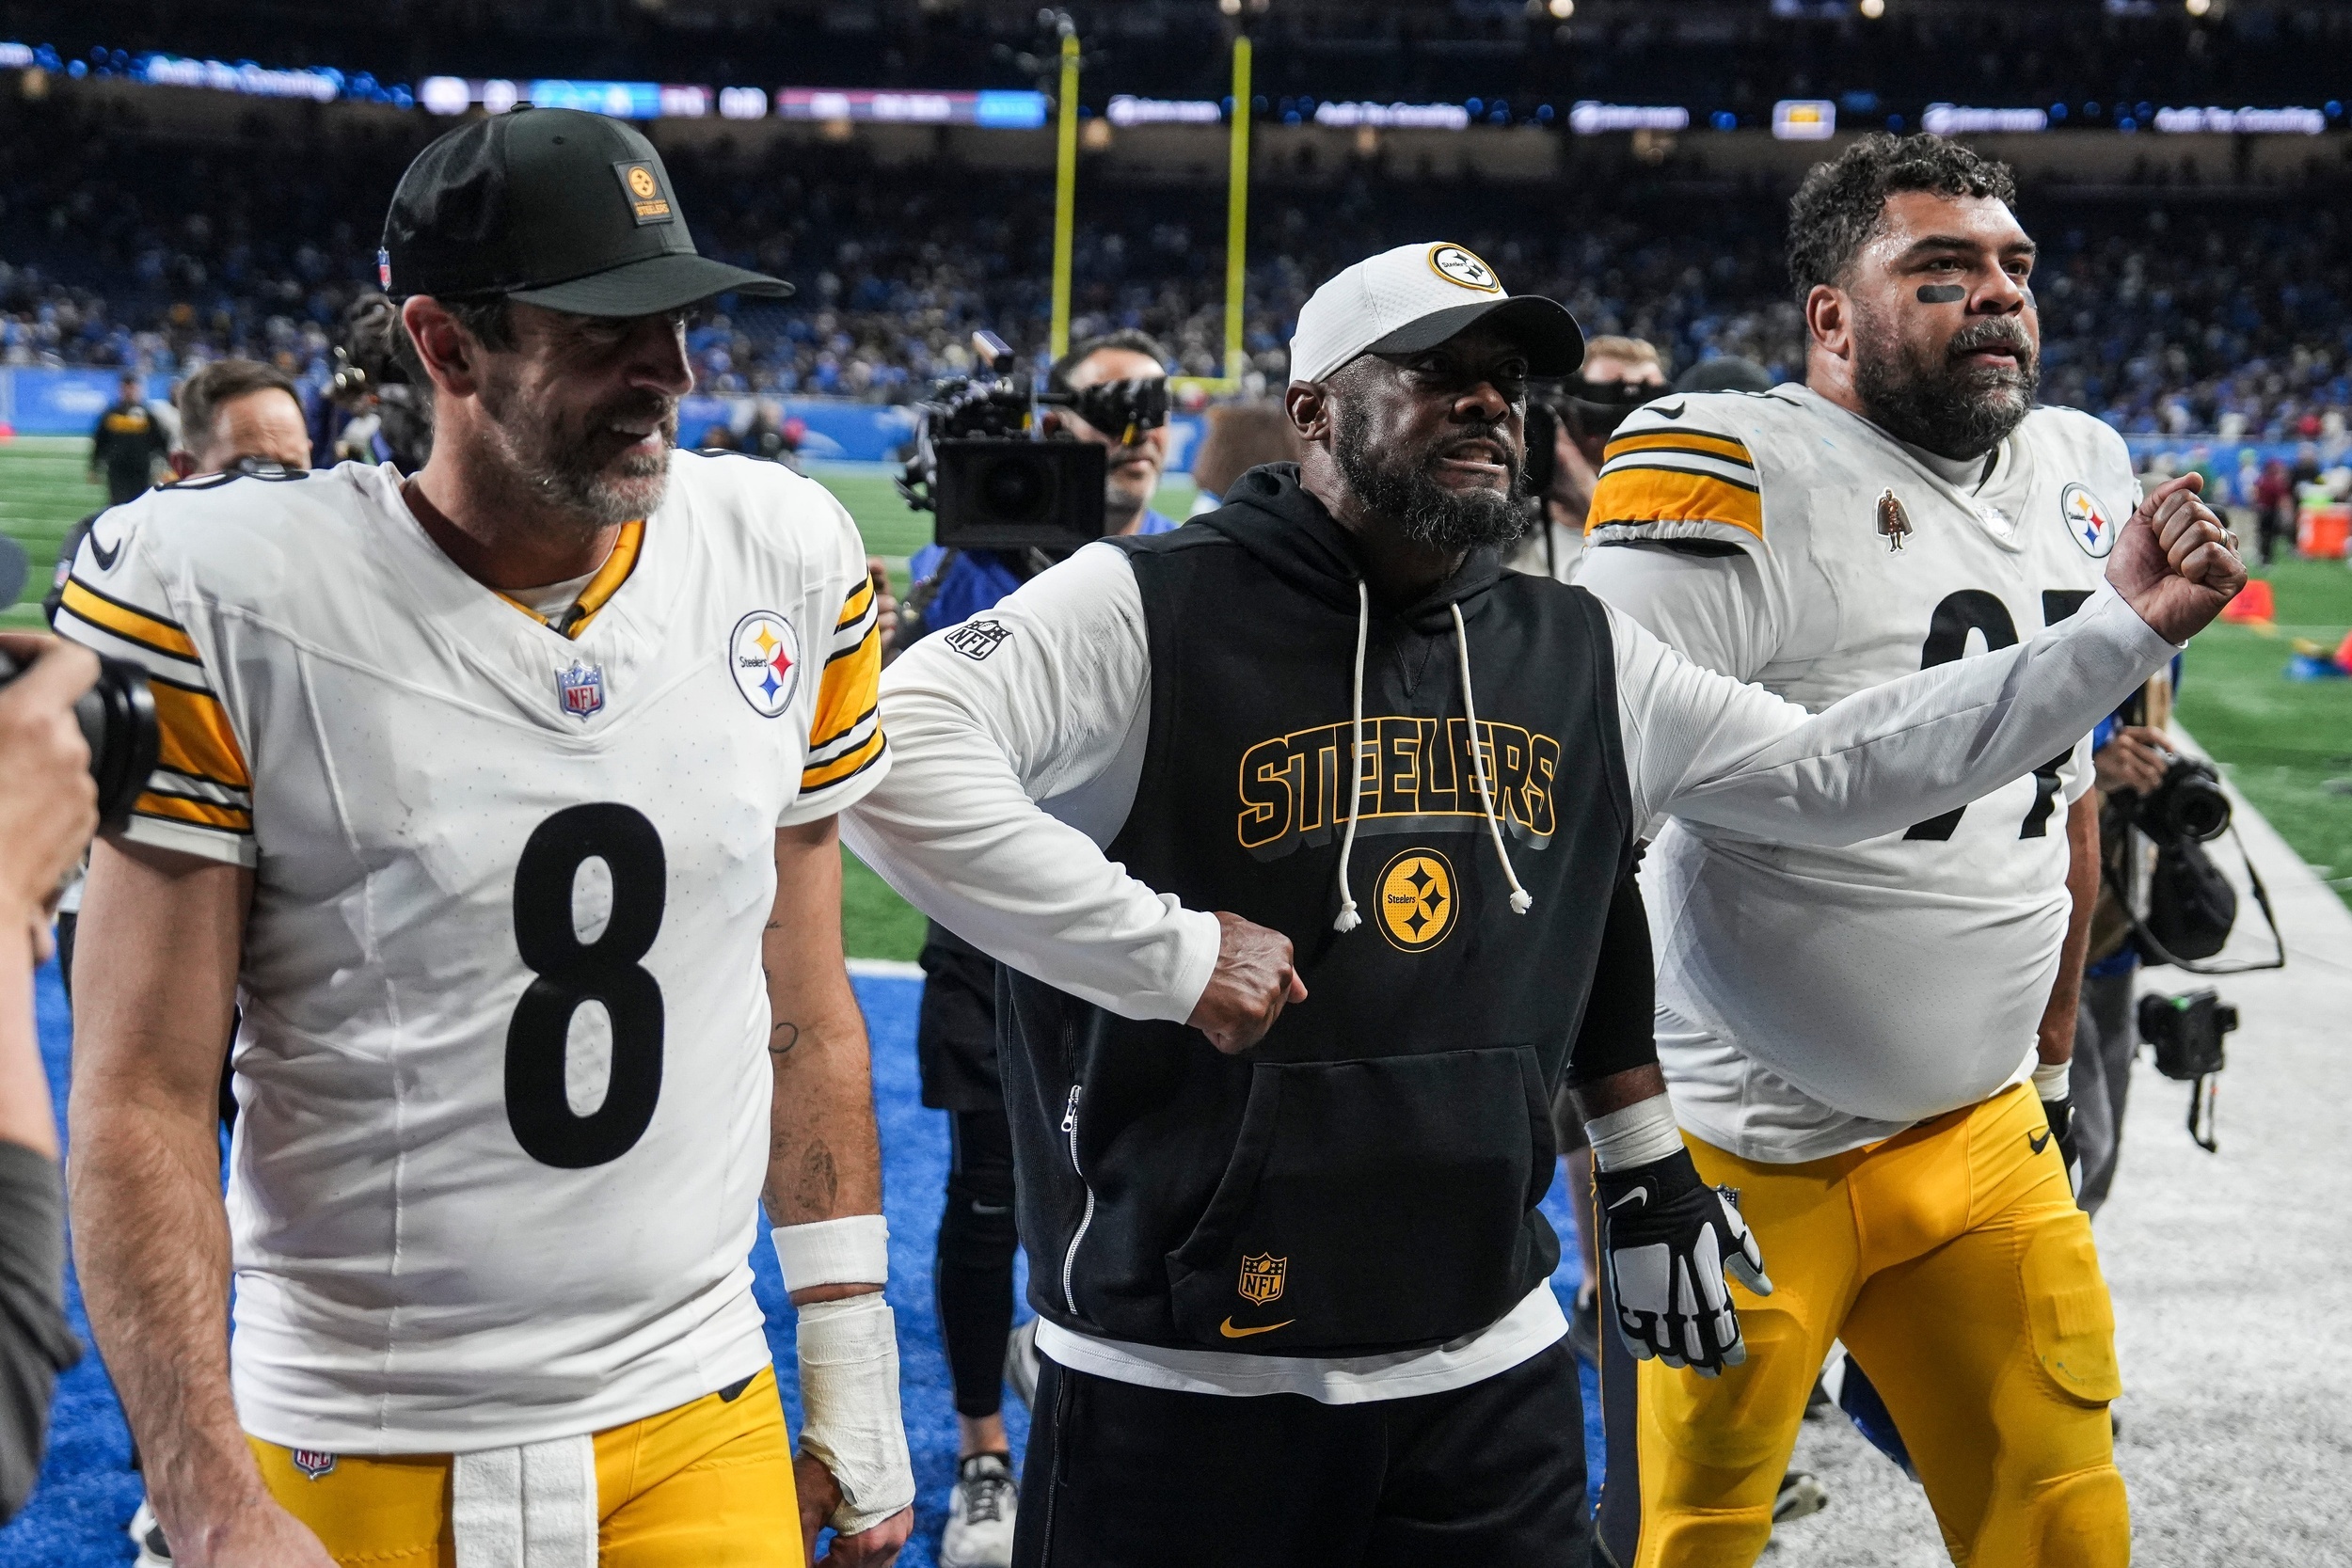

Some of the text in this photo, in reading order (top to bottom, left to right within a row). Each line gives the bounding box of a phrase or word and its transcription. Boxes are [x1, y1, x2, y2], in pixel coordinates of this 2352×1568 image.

[948, 628, 992, 657] NFL
[739, 656, 768, 668] Steelers
[567, 687, 599, 710] NFL
[1237, 716, 1561, 848] STEELERS
[1388, 894, 1416, 904] Steelers
[504, 801, 666, 1168] 8
[1244, 1274, 1279, 1297] NFL
